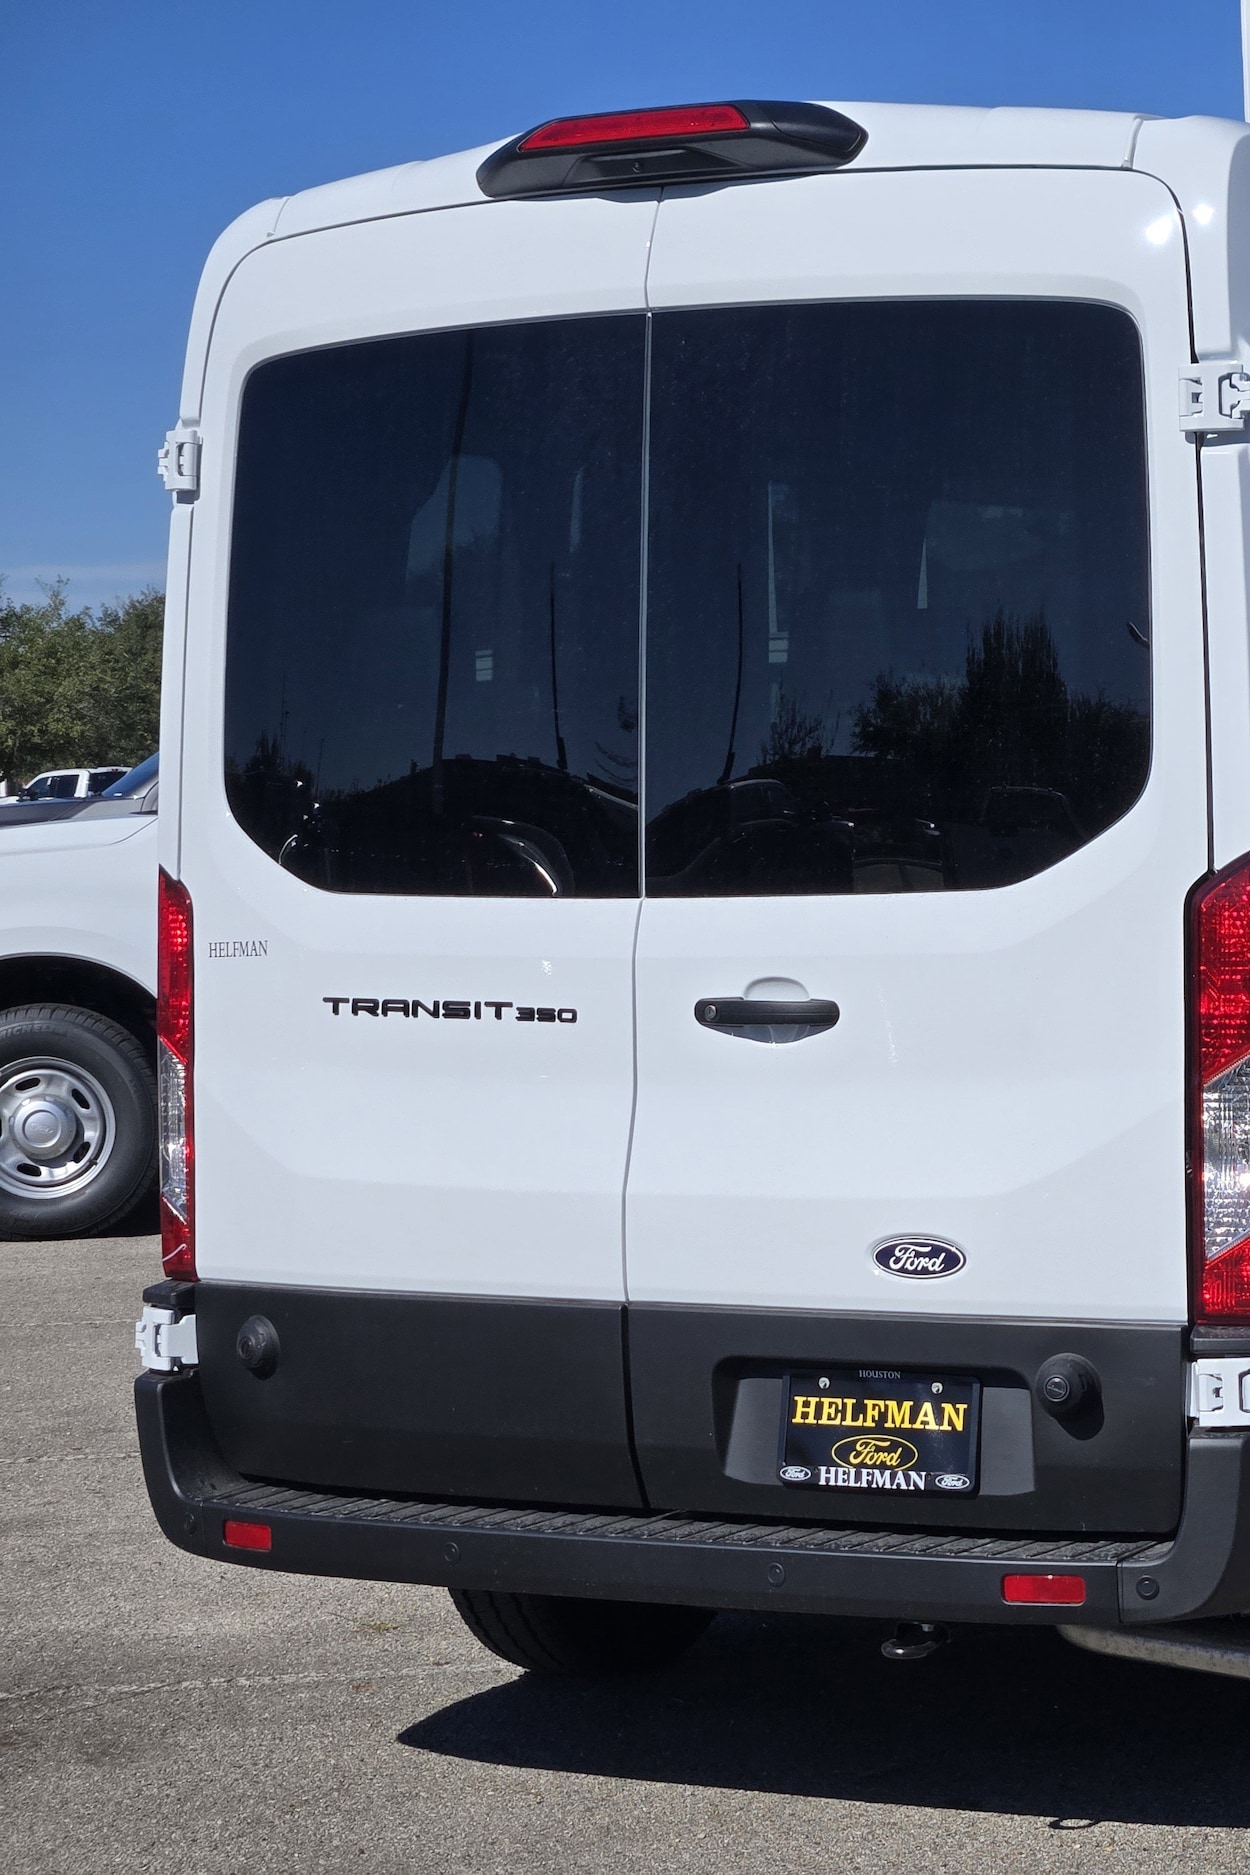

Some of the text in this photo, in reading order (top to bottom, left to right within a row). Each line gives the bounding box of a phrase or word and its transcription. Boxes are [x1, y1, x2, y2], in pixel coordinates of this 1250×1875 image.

[208, 940, 268, 958] HELFMAN
[888, 1244, 946, 1271] Ford
[858, 1369, 901, 1379] HOUSTON
[791, 1396, 968, 1432] HELFMAN
[849, 1438, 902, 1466] Ford
[818, 1467, 926, 1490] HELFMAN
